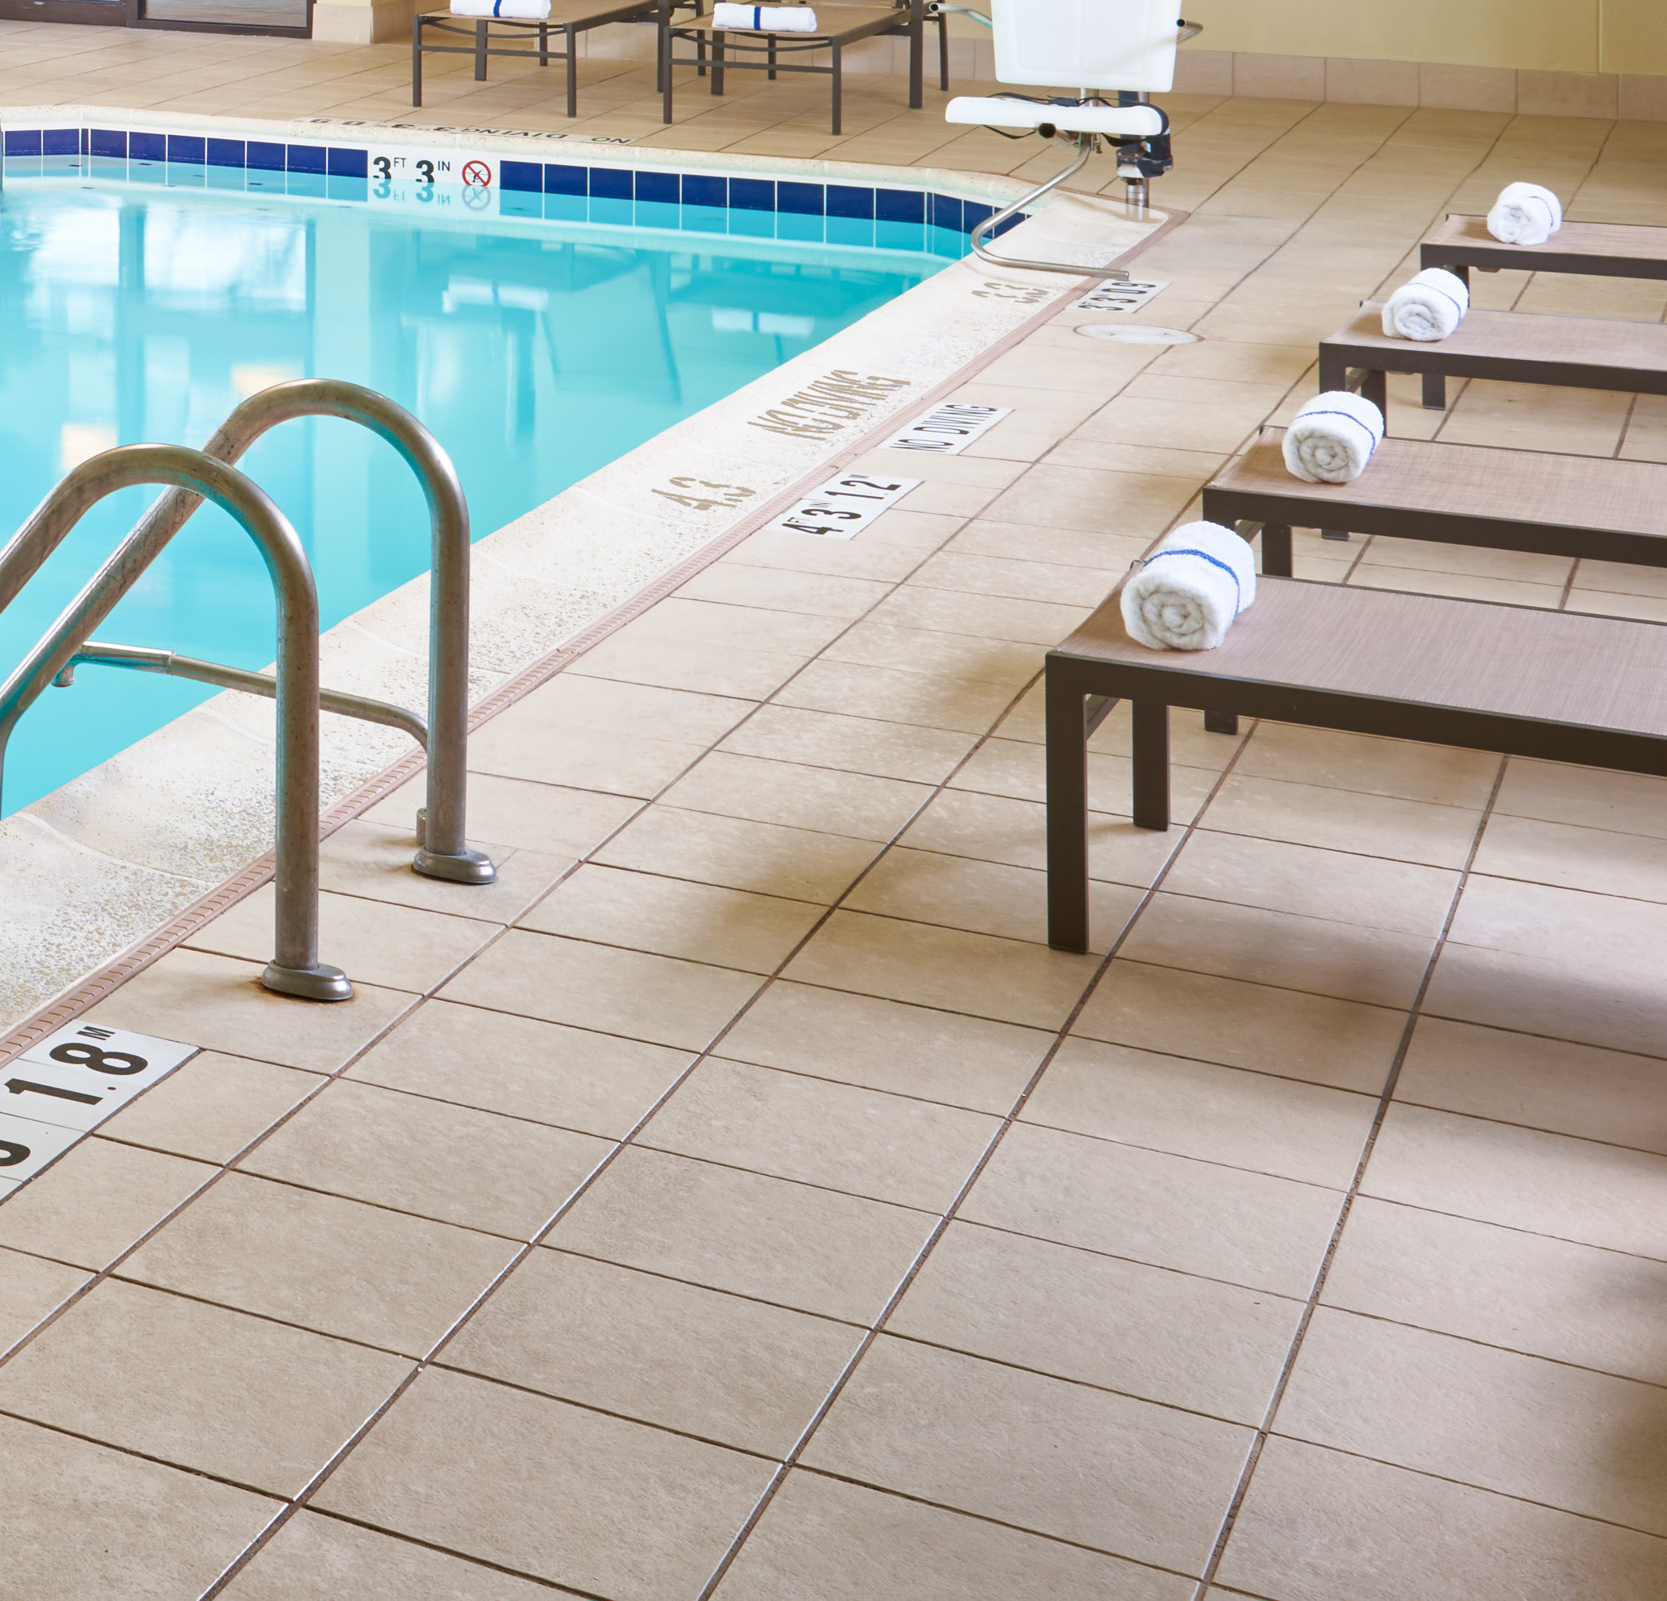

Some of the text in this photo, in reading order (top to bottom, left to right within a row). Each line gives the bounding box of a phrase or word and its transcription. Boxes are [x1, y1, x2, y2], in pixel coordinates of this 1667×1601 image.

[464, 127, 569, 140] DIVING
[591, 136, 632, 144] NO
[889, 404, 998, 453] NO DIVING
